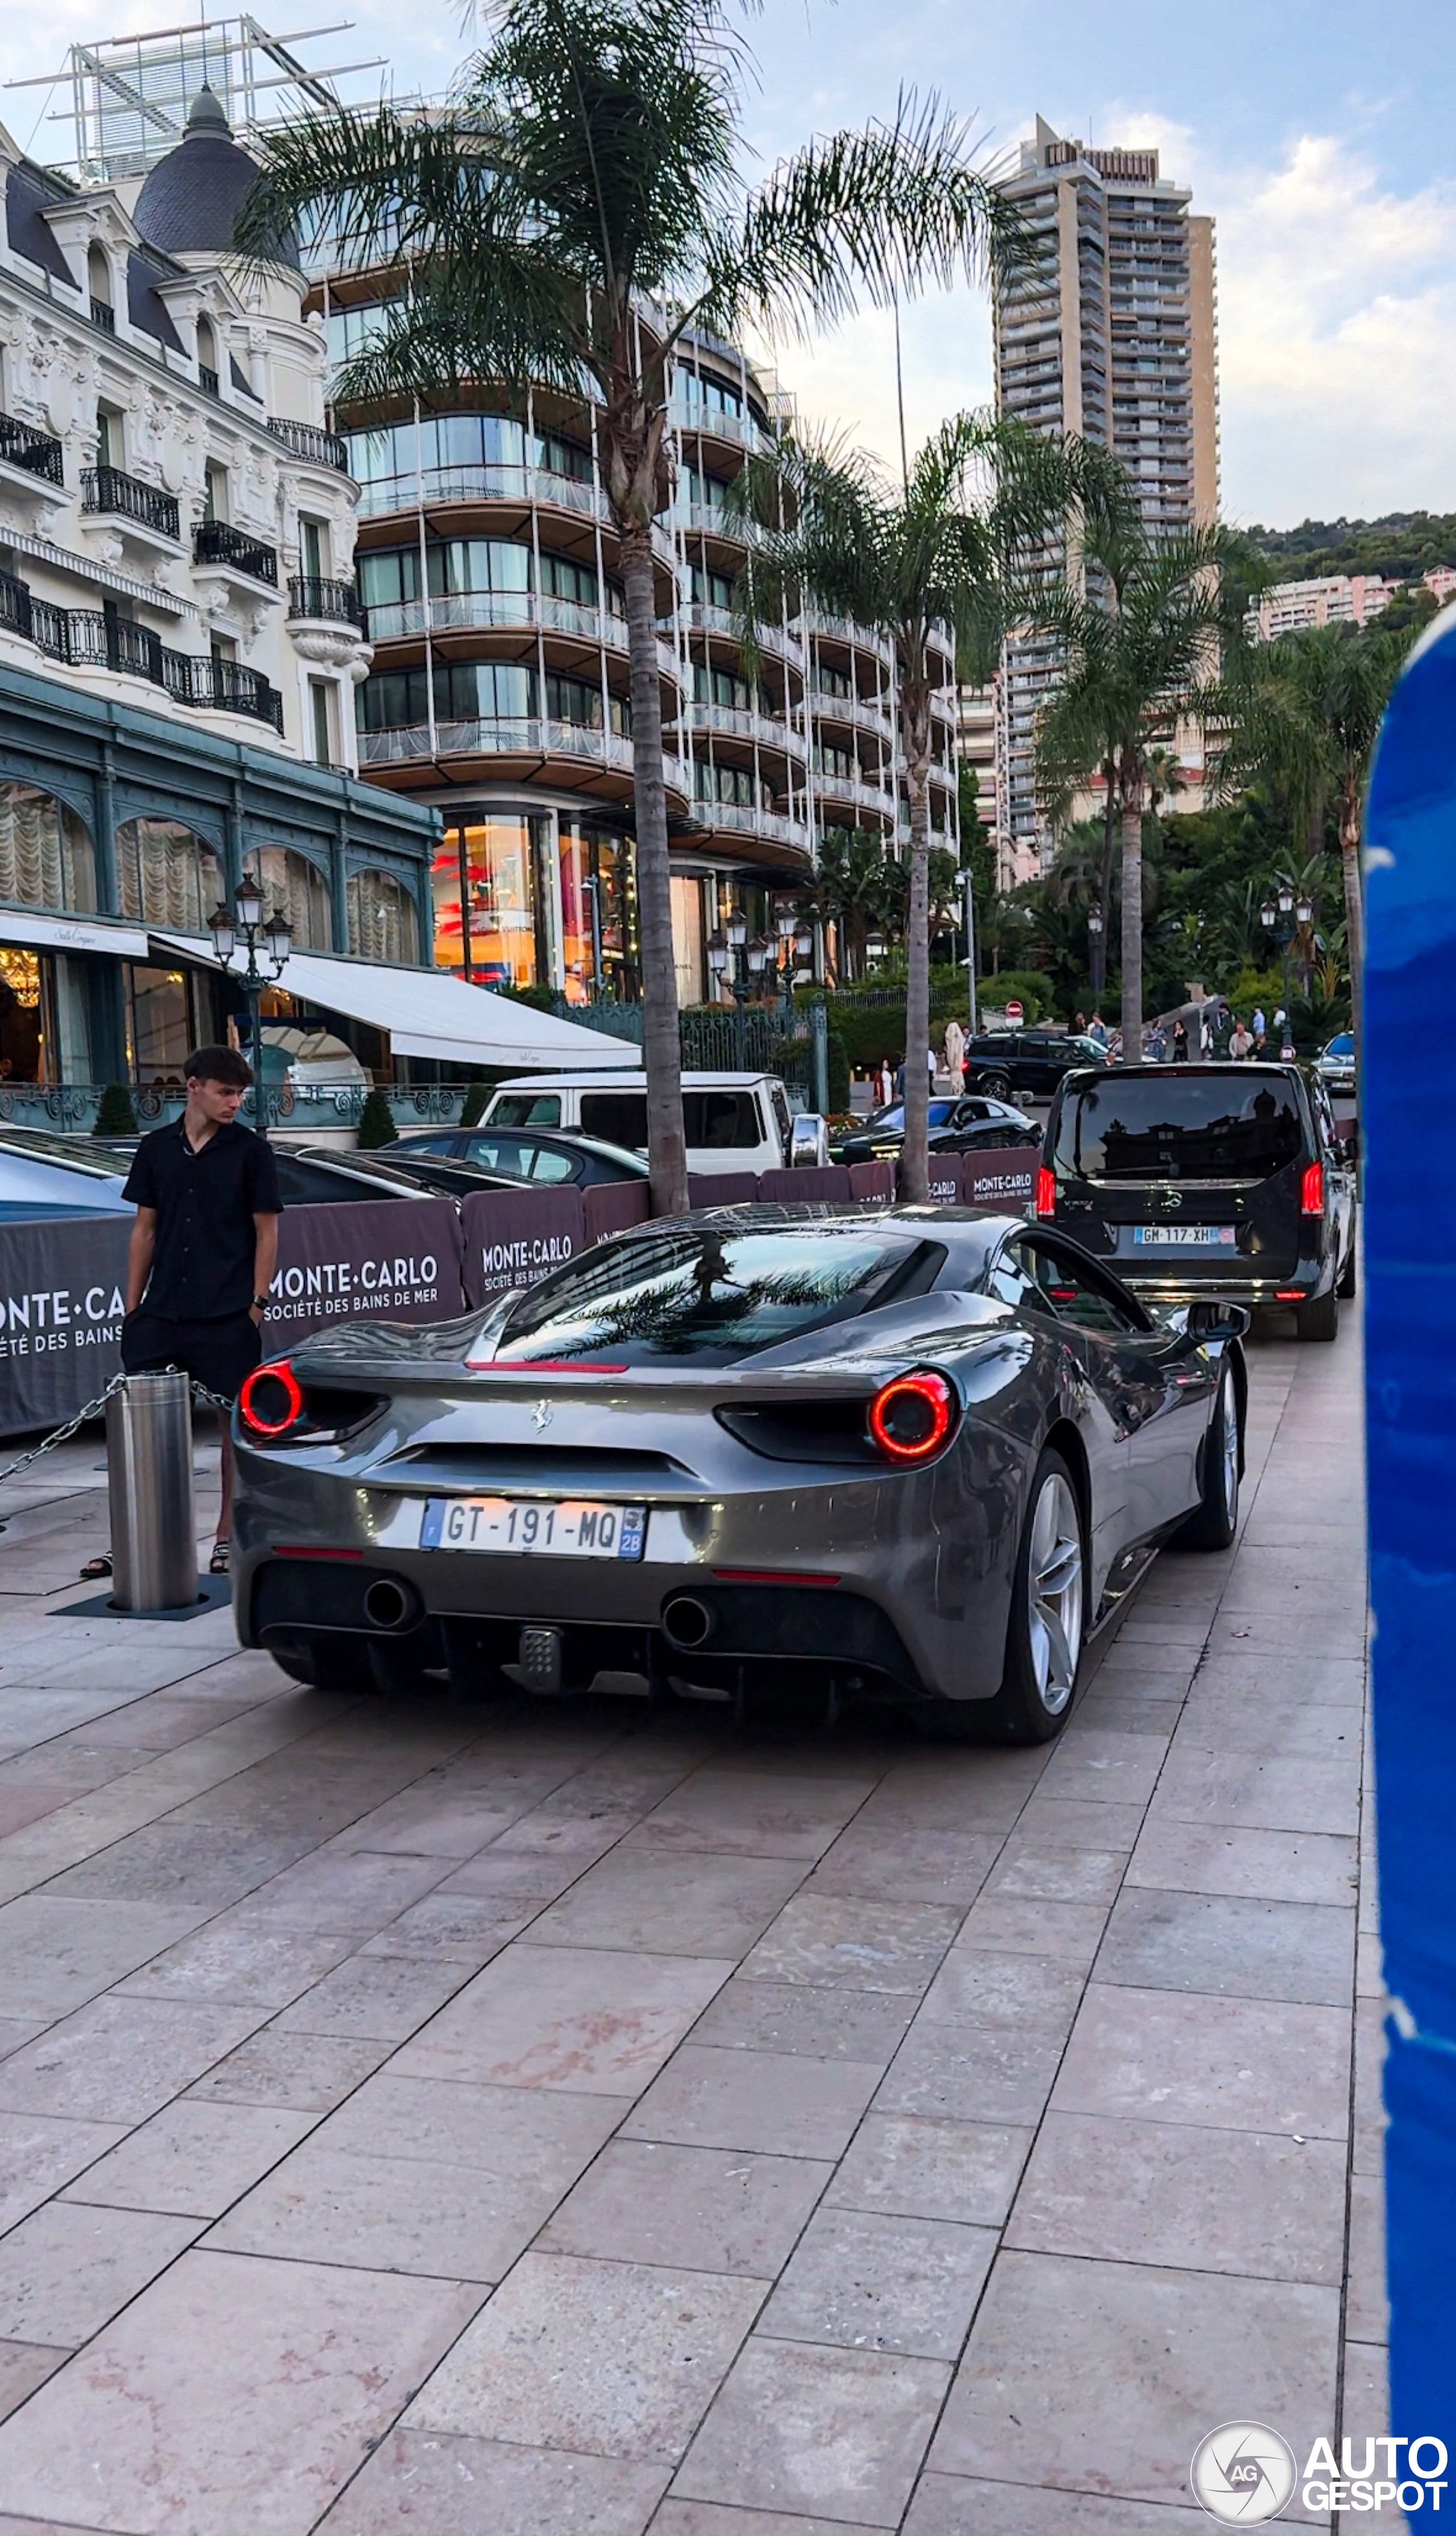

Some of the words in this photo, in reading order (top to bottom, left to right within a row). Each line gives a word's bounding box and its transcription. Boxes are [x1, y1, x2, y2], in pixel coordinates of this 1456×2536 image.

[1144, 1228, 1209, 1242] GM-117-XH
[263, 1298, 322, 1321] SOCIÉTÉ
[326, 1299, 348, 1314] DES
[353, 1293, 390, 1311] BAINS
[395, 1291, 410, 1306] DE
[415, 1288, 437, 1304] MER
[35, 1332, 67, 1353] DES
[75, 1325, 123, 1347] BAINS
[448, 1506, 616, 1548] GT-191-MQ
[621, 1535, 640, 1552] 2B
